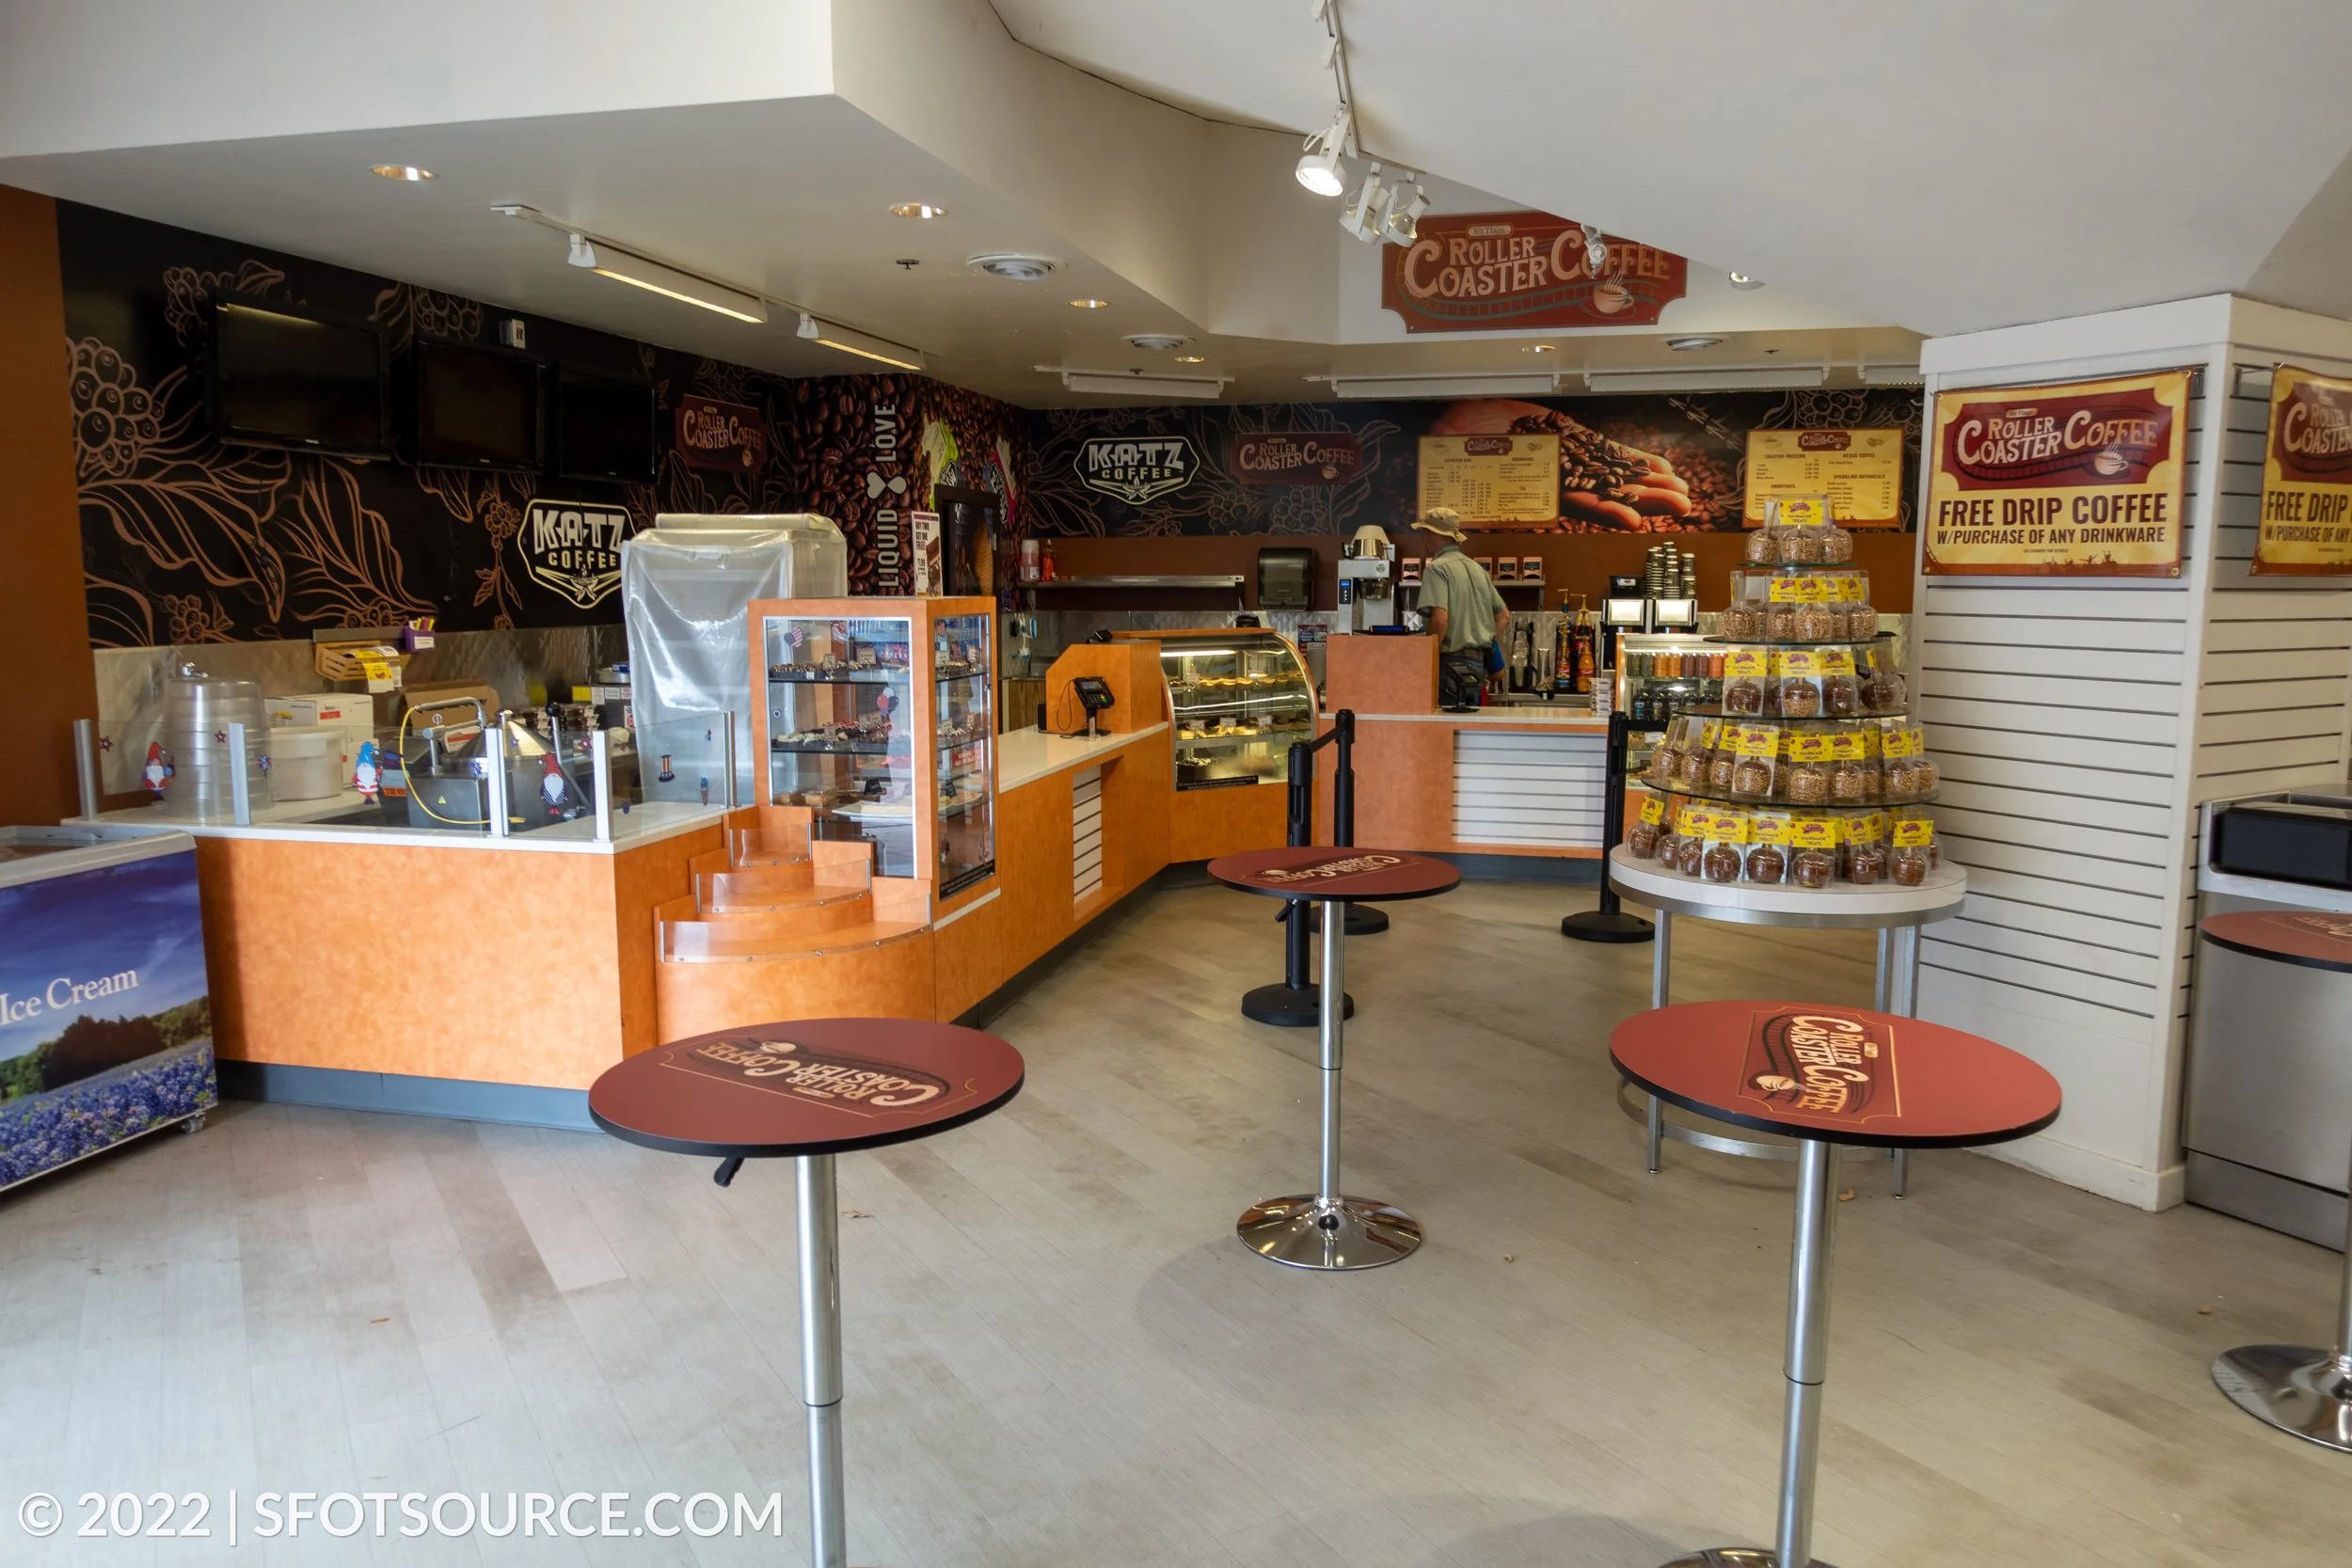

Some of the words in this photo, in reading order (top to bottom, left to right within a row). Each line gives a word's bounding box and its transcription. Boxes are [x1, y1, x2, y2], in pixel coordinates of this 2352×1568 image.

[1472, 226, 1484, 234] Six
[1450, 236, 1536, 266] ROLLER
[1404, 240, 1548, 298] COASTER
[683, 409, 729, 450] COASTER
[697, 411, 725, 431] ROLLER
[874, 404, 898, 463] LOVE
[1988, 416, 2055, 440] ROLLER
[1259, 443, 1297, 456] ROLLER
[1957, 420, 2061, 466] COASTER
[2064, 410, 2159, 450] COFFEE
[1089, 442, 1184, 473] KATZ
[1240, 443, 1303, 470] COASTER
[1303, 441, 1355, 466] COFFEE
[1102, 467, 1171, 480] COFFEE
[1938, 499, 1994, 527] FREE
[2002, 498, 2063, 526] DRIP
[2072, 493, 2169, 525] COFFEE
[2266, 490, 2305, 521] FREE
[2307, 493, 2348, 523] DRIP
[532, 509, 626, 555] KATZ
[1936, 530, 2024, 545] W/PURCHASE
[2029, 529, 2045, 544] OF
[2049, 528, 2075, 544] ANY
[2080, 527, 2166, 543] DRINKWARE
[2265, 525, 2319, 544] W/PURCHASE
[2322, 527, 2333, 543] OF
[2334, 527, 2349, 544] ANY
[548, 549, 617, 569] COFFEE
[876, 509, 900, 588] LIQUID
[0, 993, 41, 1025] Ice
[46, 970, 139, 1010] Cream
[1790, 1016, 1864, 1066] COASTER
[1829, 1032, 1865, 1064] ROLLER
[696, 1042, 801, 1076] COFFEE
[786, 1076, 877, 1100] ROLLER
[793, 1063, 940, 1106] COASTER
[1795, 1065, 1869, 1114] COFFEE
